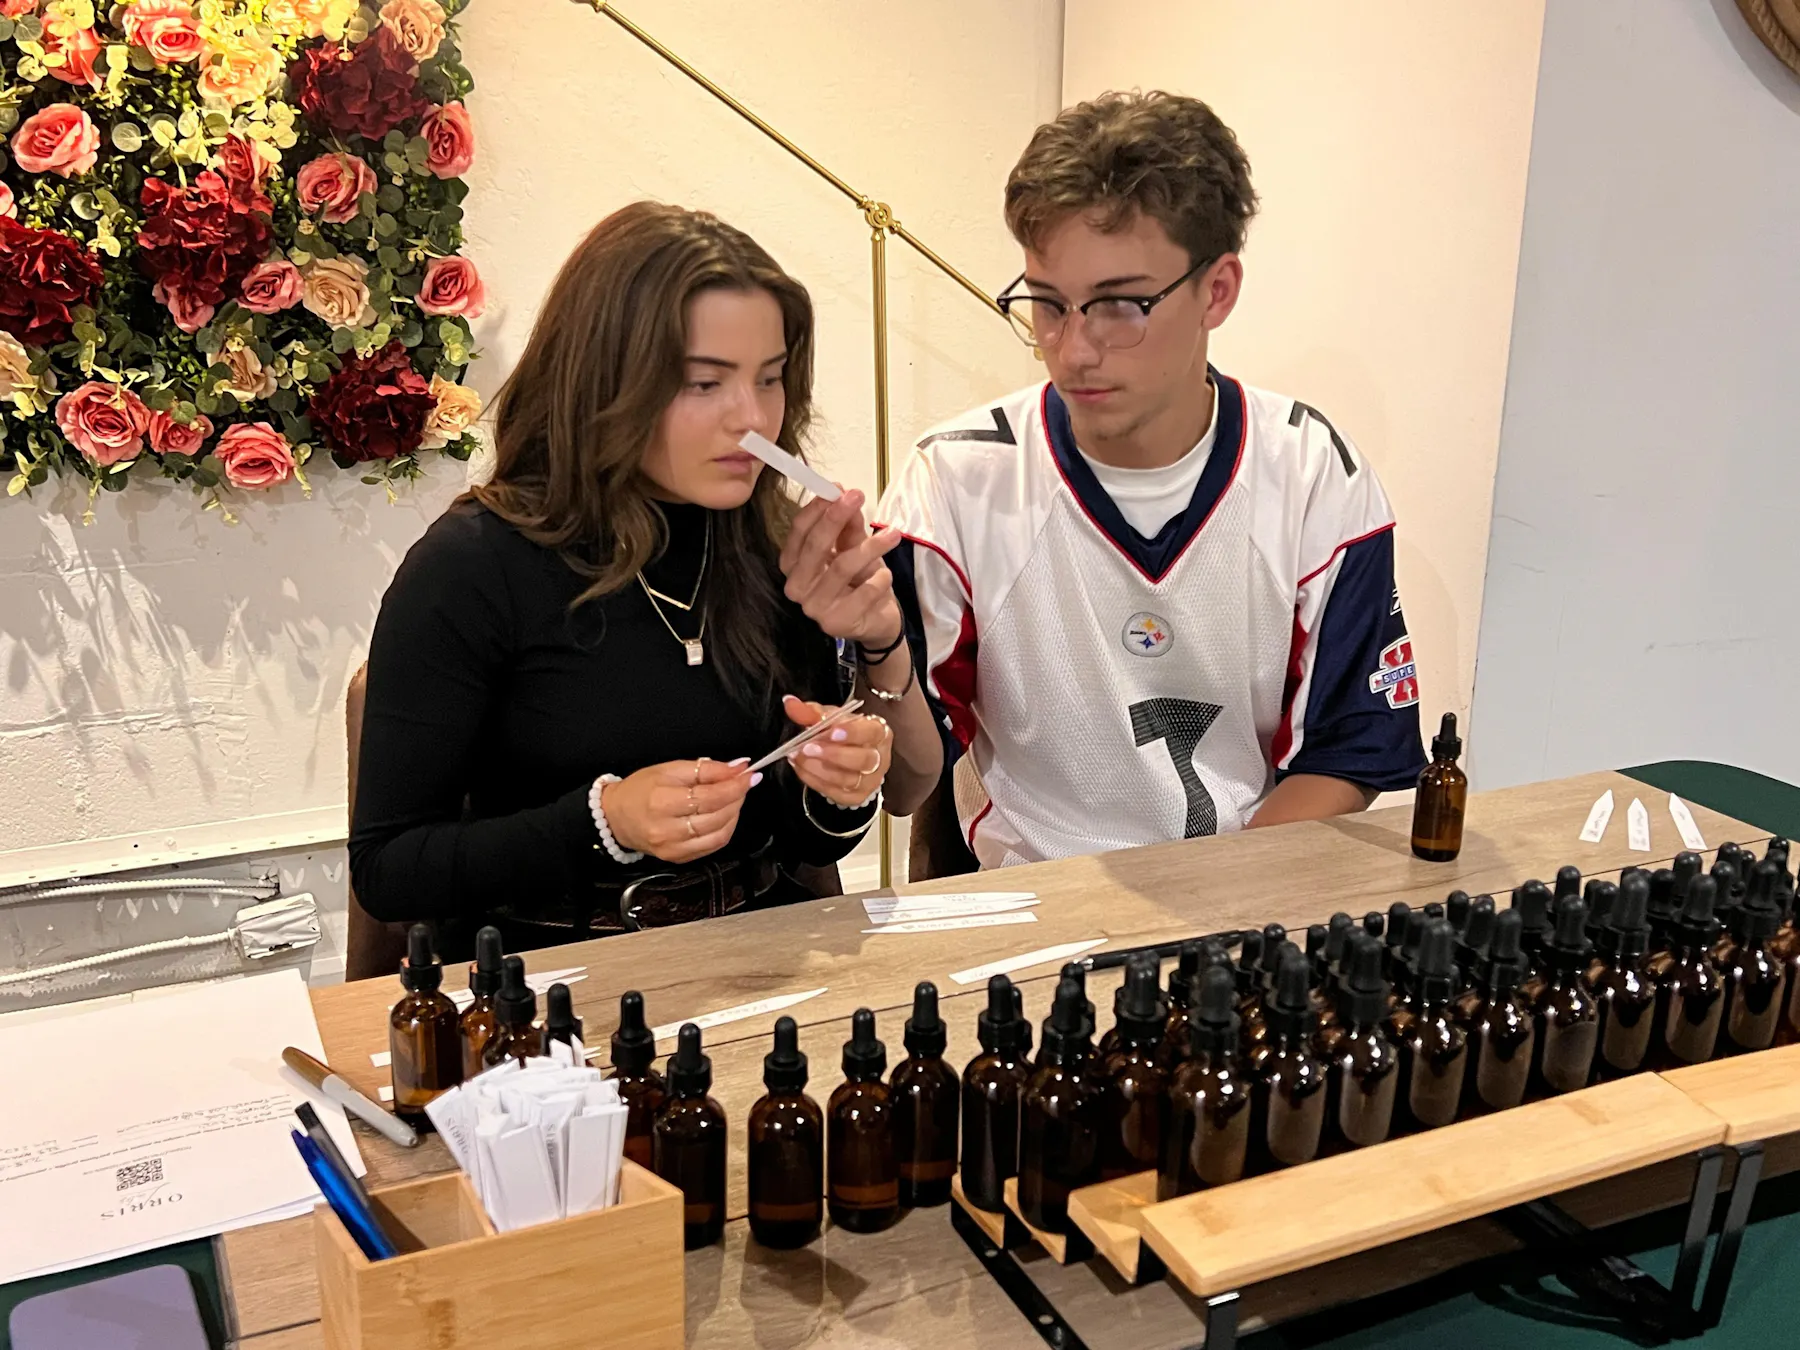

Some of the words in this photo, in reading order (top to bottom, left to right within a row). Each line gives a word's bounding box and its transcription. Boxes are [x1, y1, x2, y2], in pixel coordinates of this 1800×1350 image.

[916, 407, 1017, 448] 7
[1288, 400, 1357, 478] 7
[1128, 697, 1224, 839] 7
[100, 1193, 183, 1221] ORRIS
